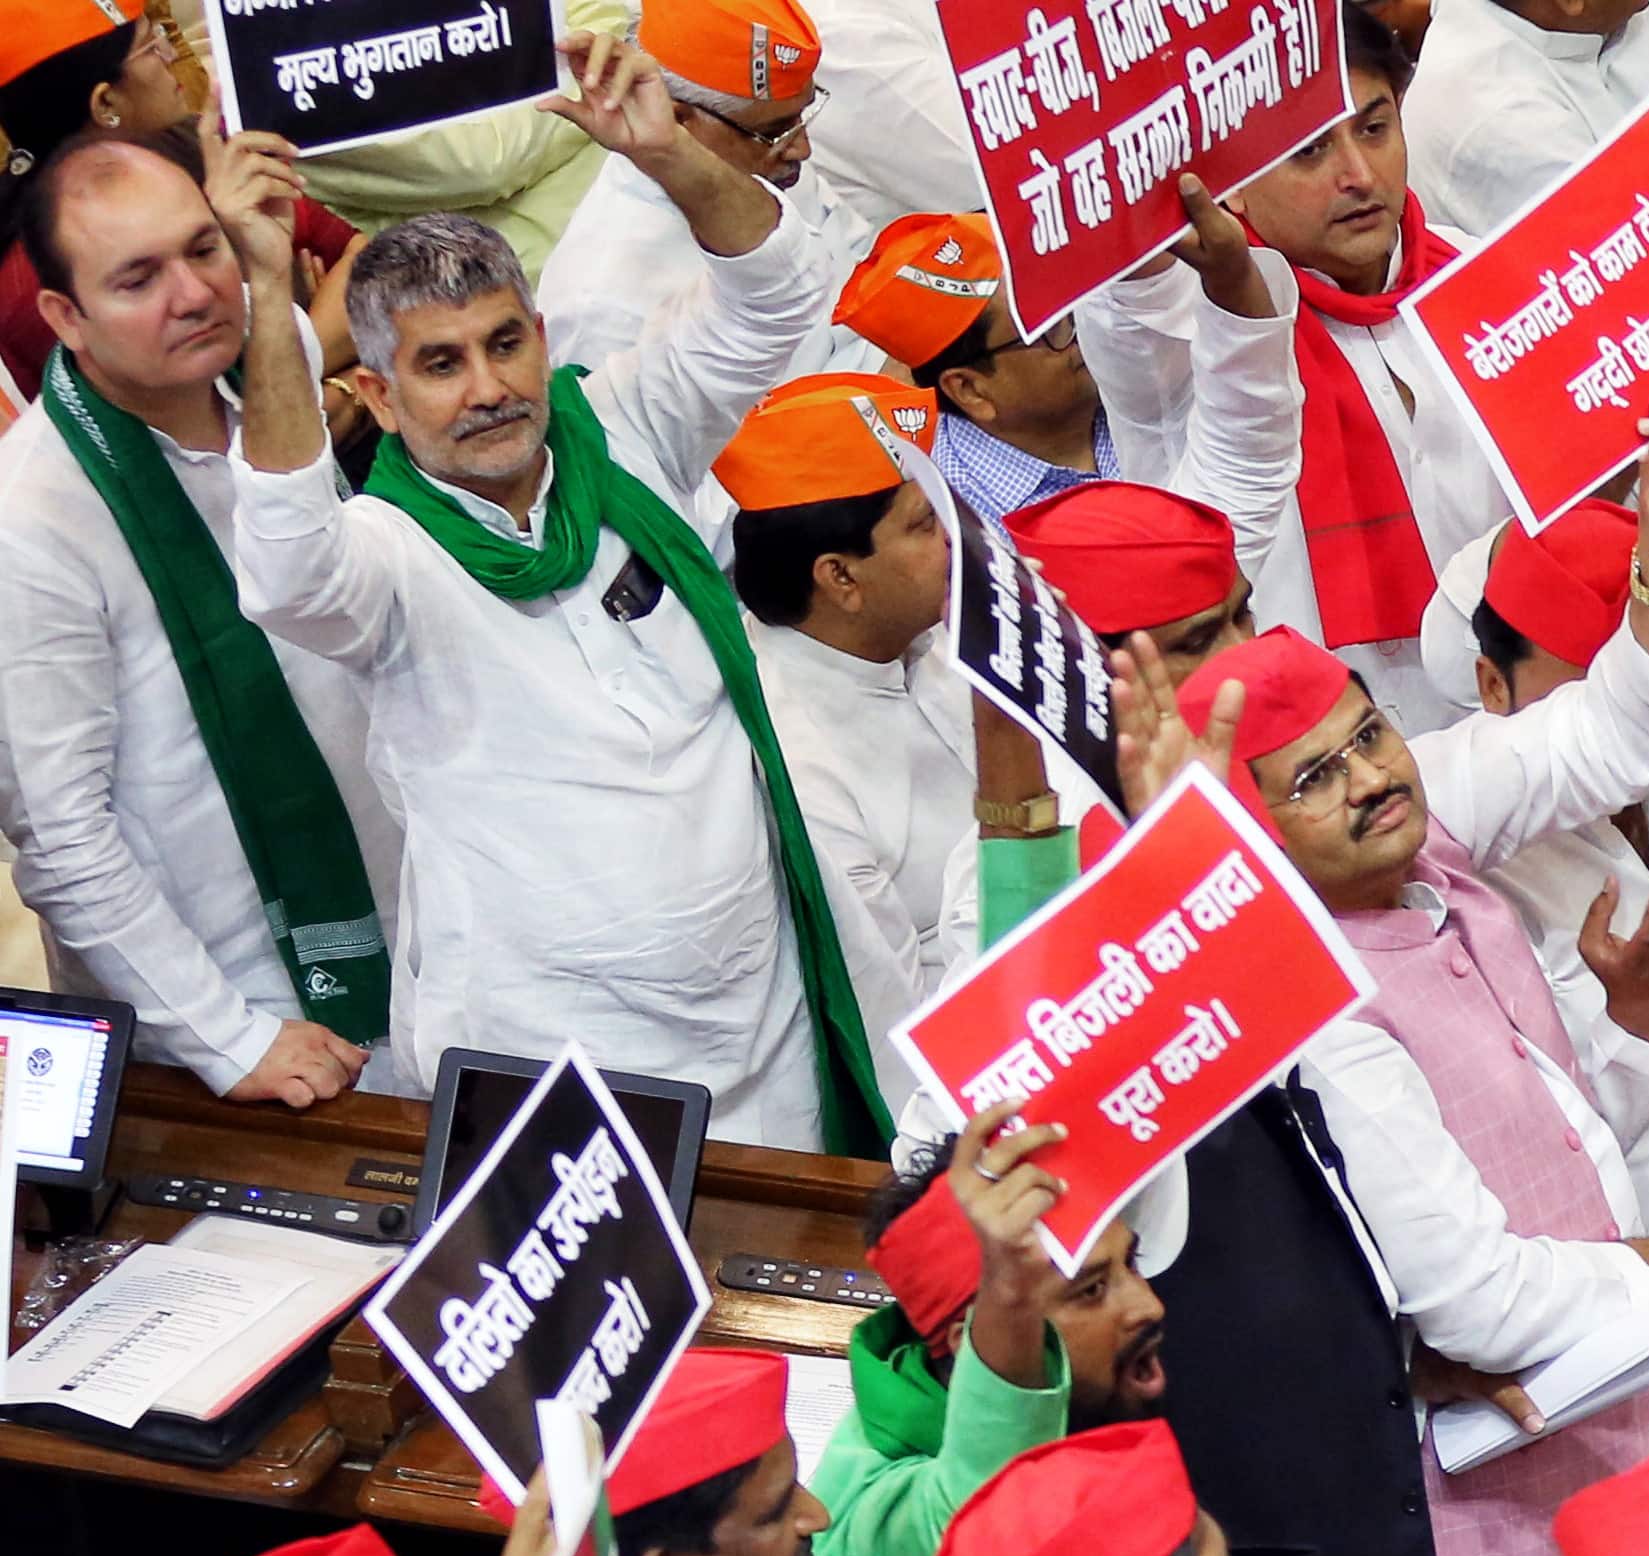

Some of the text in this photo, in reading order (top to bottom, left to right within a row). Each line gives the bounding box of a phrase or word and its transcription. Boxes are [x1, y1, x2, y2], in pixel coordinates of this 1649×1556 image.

[273, 1, 512, 111] मूल्य भुगतान करो।
[1018, 148, 1070, 256] जो
[1063, 138, 1112, 229] वह
[1107, 84, 1192, 206] सरकार
[1185, 5, 1283, 153] निकम्मी
[1463, 270, 1574, 381] बेरोजगारों
[1561, 249, 1605, 307] को
[1590, 222, 1648, 283] काम
[1025, 942, 1154, 1067] बिजली
[1134, 909, 1200, 973] का
[1181, 849, 1265, 932] वादा
[1098, 997, 1243, 1142] पूरा करो।
[506, 1229, 565, 1300] का
